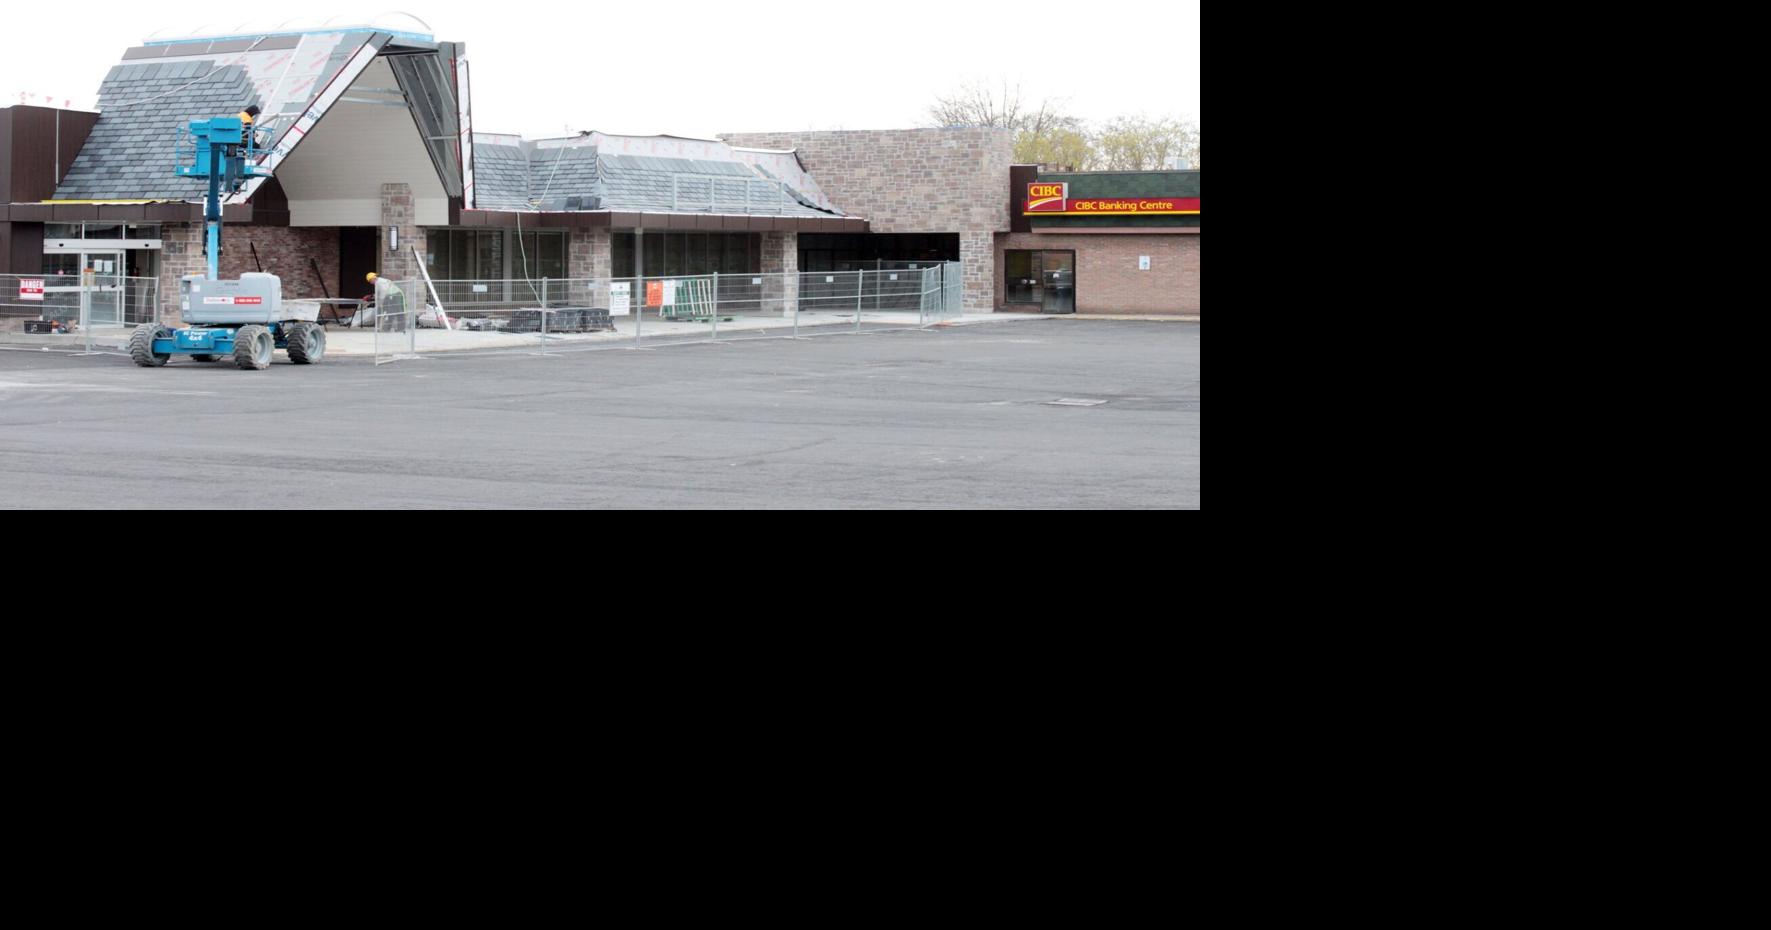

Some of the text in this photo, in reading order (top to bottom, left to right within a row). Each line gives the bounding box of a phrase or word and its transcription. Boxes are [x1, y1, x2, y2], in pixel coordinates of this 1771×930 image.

[1030, 185, 1062, 197] CIBC
[1075, 201, 1173, 214] CIBC Banking Centre
